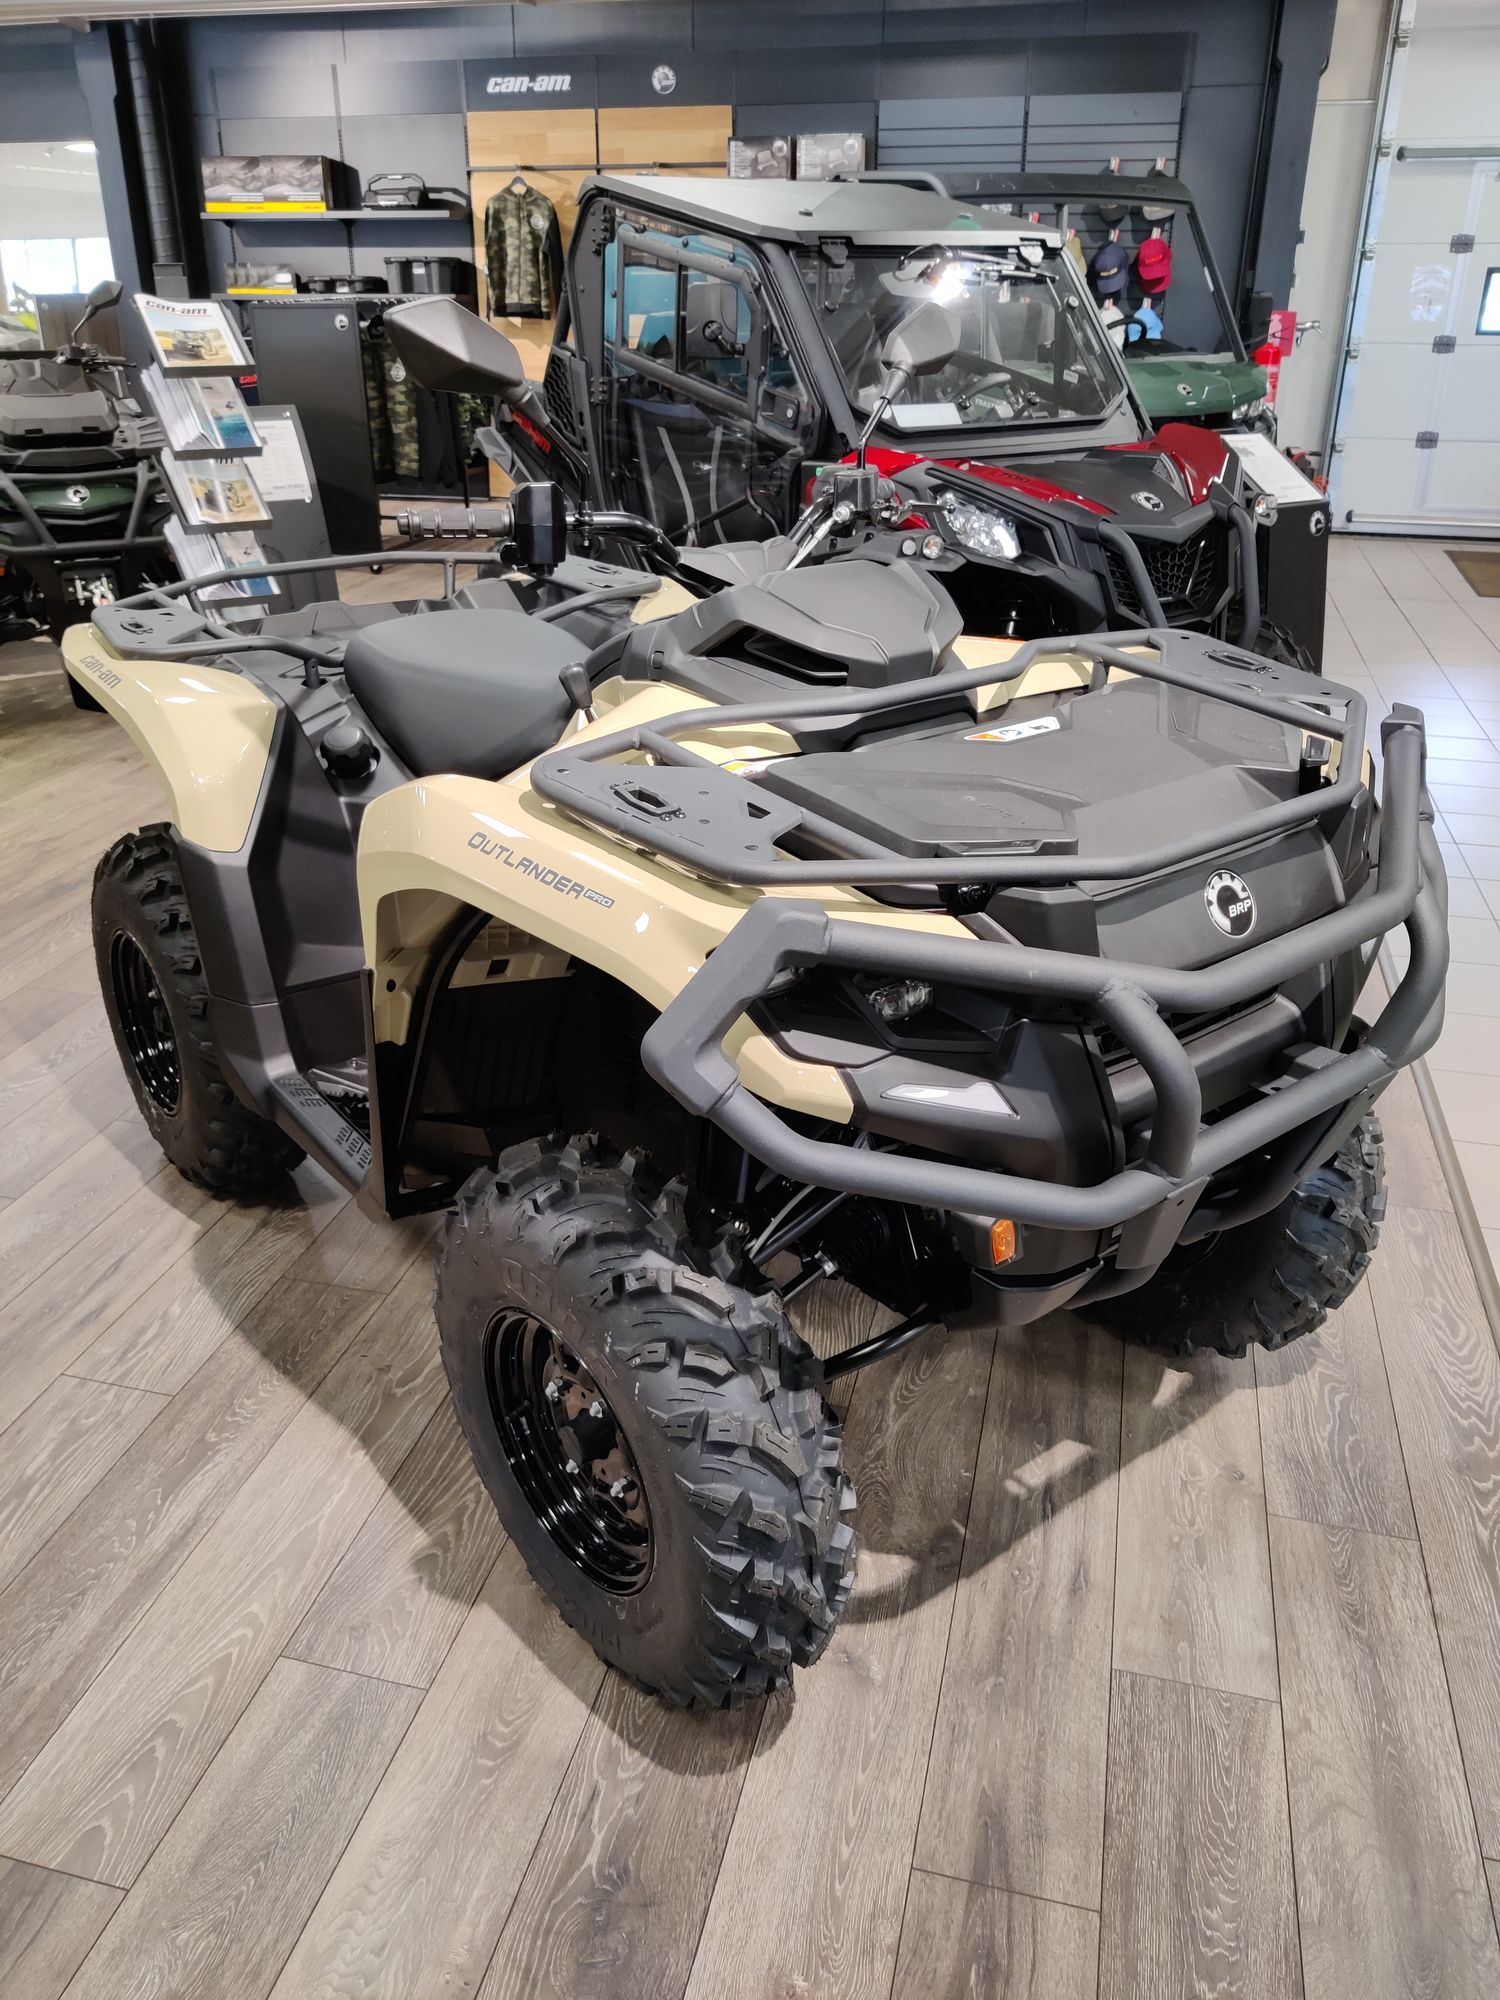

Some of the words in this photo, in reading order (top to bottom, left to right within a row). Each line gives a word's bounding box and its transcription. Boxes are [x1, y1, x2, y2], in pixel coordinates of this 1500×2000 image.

[486, 74, 572, 93] can-am
[79, 655, 122, 690] can-am
[466, 831, 585, 900] OUTLANDER
[584, 889, 614, 908] PRO
[1228, 899, 1252, 918] BRP
